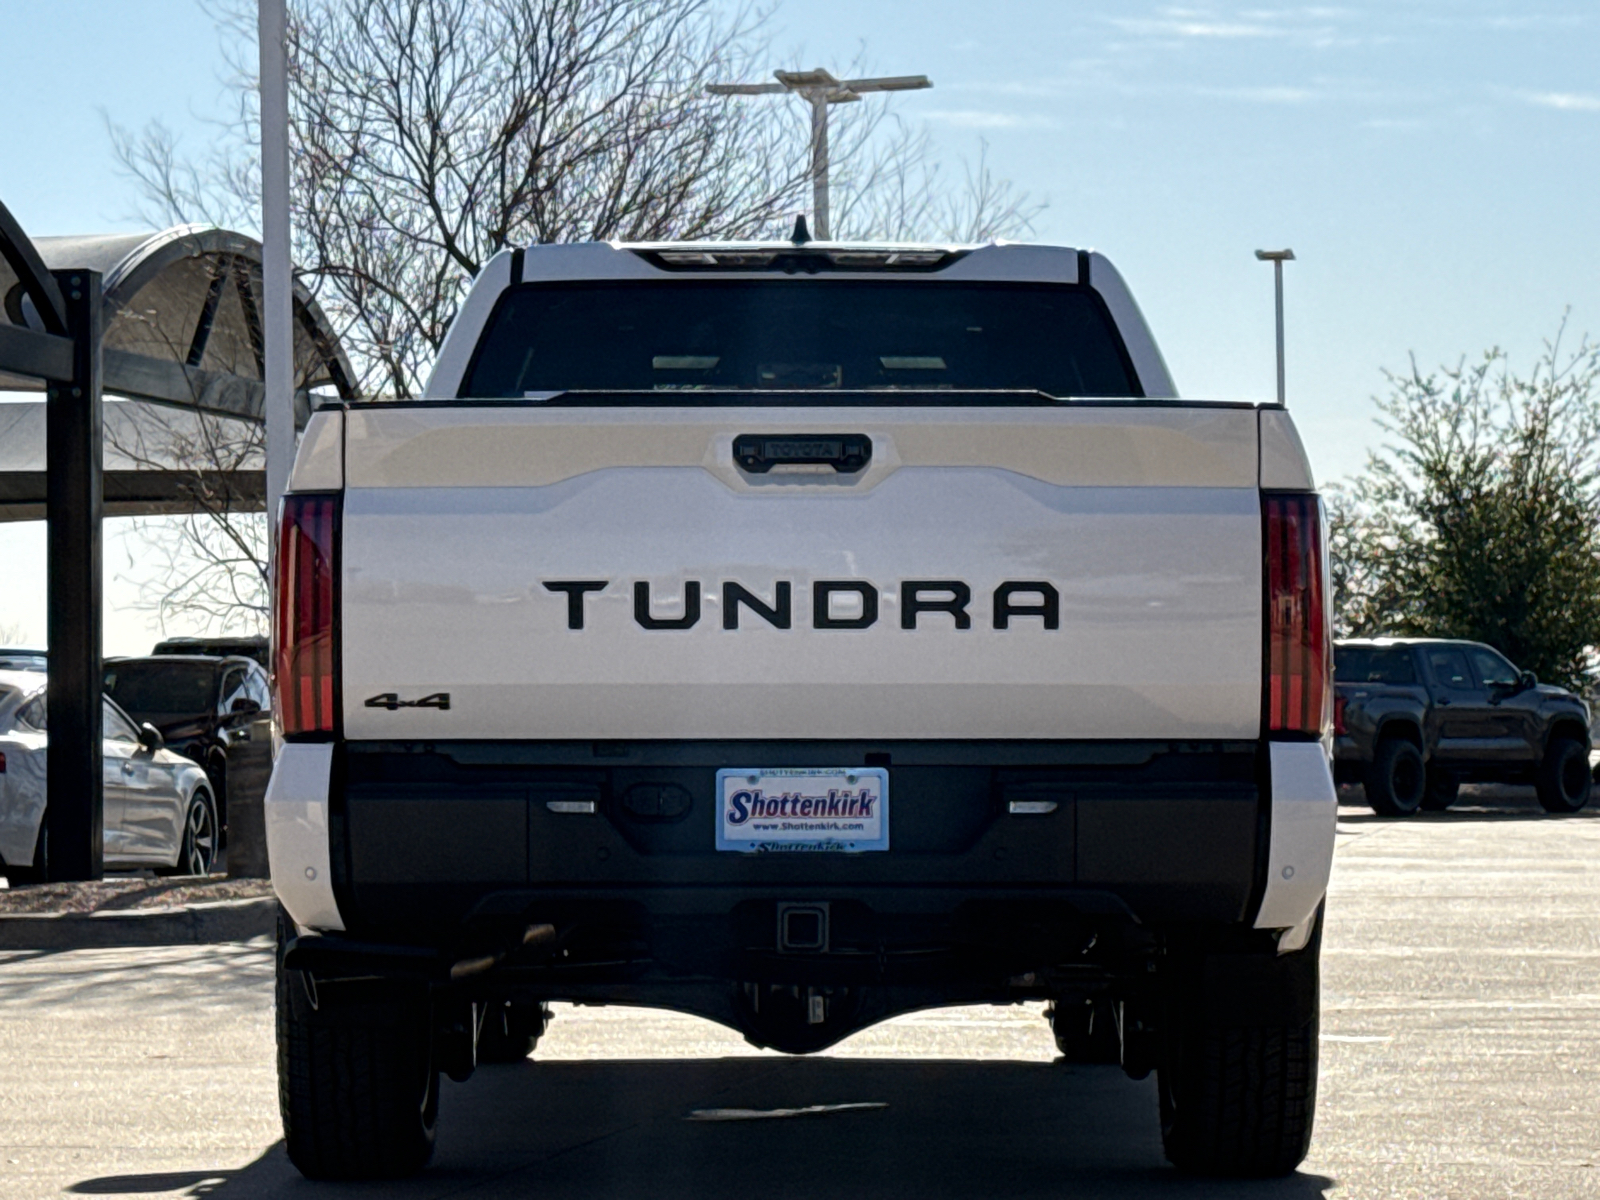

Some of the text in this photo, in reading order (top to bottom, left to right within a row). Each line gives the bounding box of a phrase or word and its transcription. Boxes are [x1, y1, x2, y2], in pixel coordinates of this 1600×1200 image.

[770, 443, 834, 457] TOYOTA
[541, 580, 1060, 630] TUNDRA
[727, 789, 876, 825] Shottenkirk
[753, 822, 864, 831] www.Shottenkirk.com
